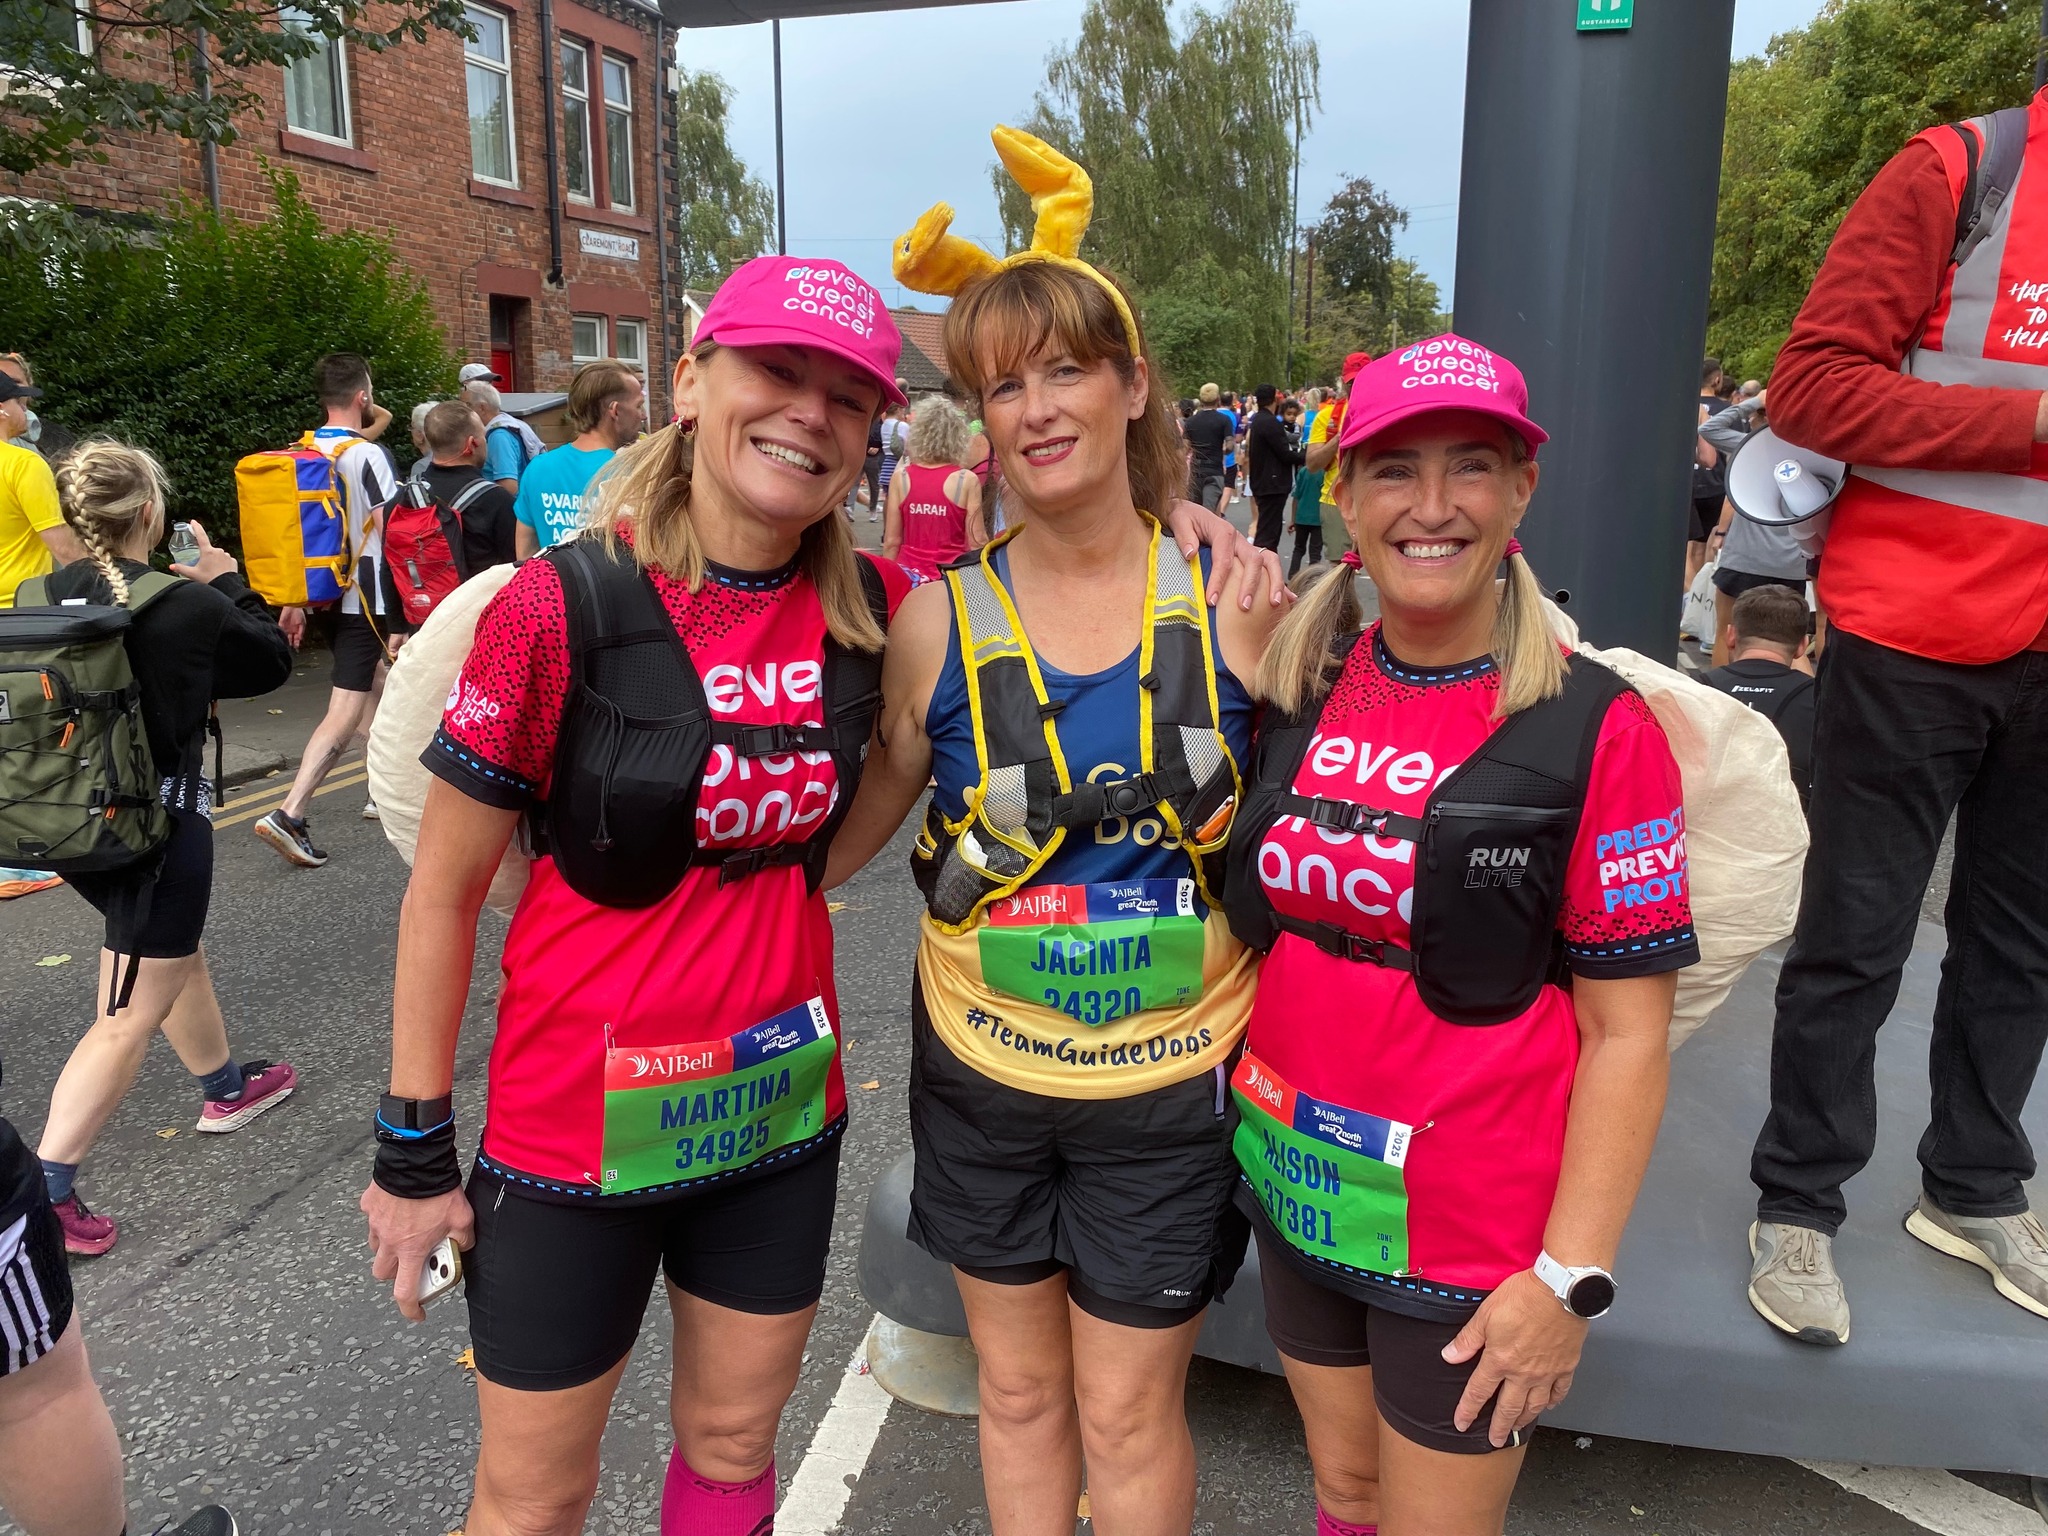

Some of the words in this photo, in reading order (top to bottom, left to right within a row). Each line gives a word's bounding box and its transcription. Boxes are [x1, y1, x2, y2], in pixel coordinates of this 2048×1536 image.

[582, 235, 616, 251] CLAREMONT
[785, 265, 875, 306] prevent
[798, 280, 875, 323] breast
[783, 297, 873, 339] cancer
[2026, 306, 2047, 325] TO
[1398, 340, 1492, 365] prevent
[1414, 356, 1496, 379] breast
[1402, 372, 1499, 393] cancer
[909, 503, 947, 516] SARAH
[1468, 848, 1531, 867] RUN
[1464, 869, 1526, 888] LITE
[1030, 935, 1151, 976] JACINTA
[813, 1005, 826, 1029] 2025
[966, 1006, 1212, 1066] #TeamGuideDogs
[660, 1068, 791, 1130] MARTINA
[803, 1111, 810, 1127] F
[675, 1116, 770, 1170] 34925
[1342, 1130, 1362, 1143] north
[1391, 1131, 1404, 1158] 2025
[1263, 1127, 1341, 1196] ALISON
[1264, 1178, 1337, 1248] 37381
[1377, 1232, 1392, 1243] ZONE
[1381, 1245, 1389, 1261] G
